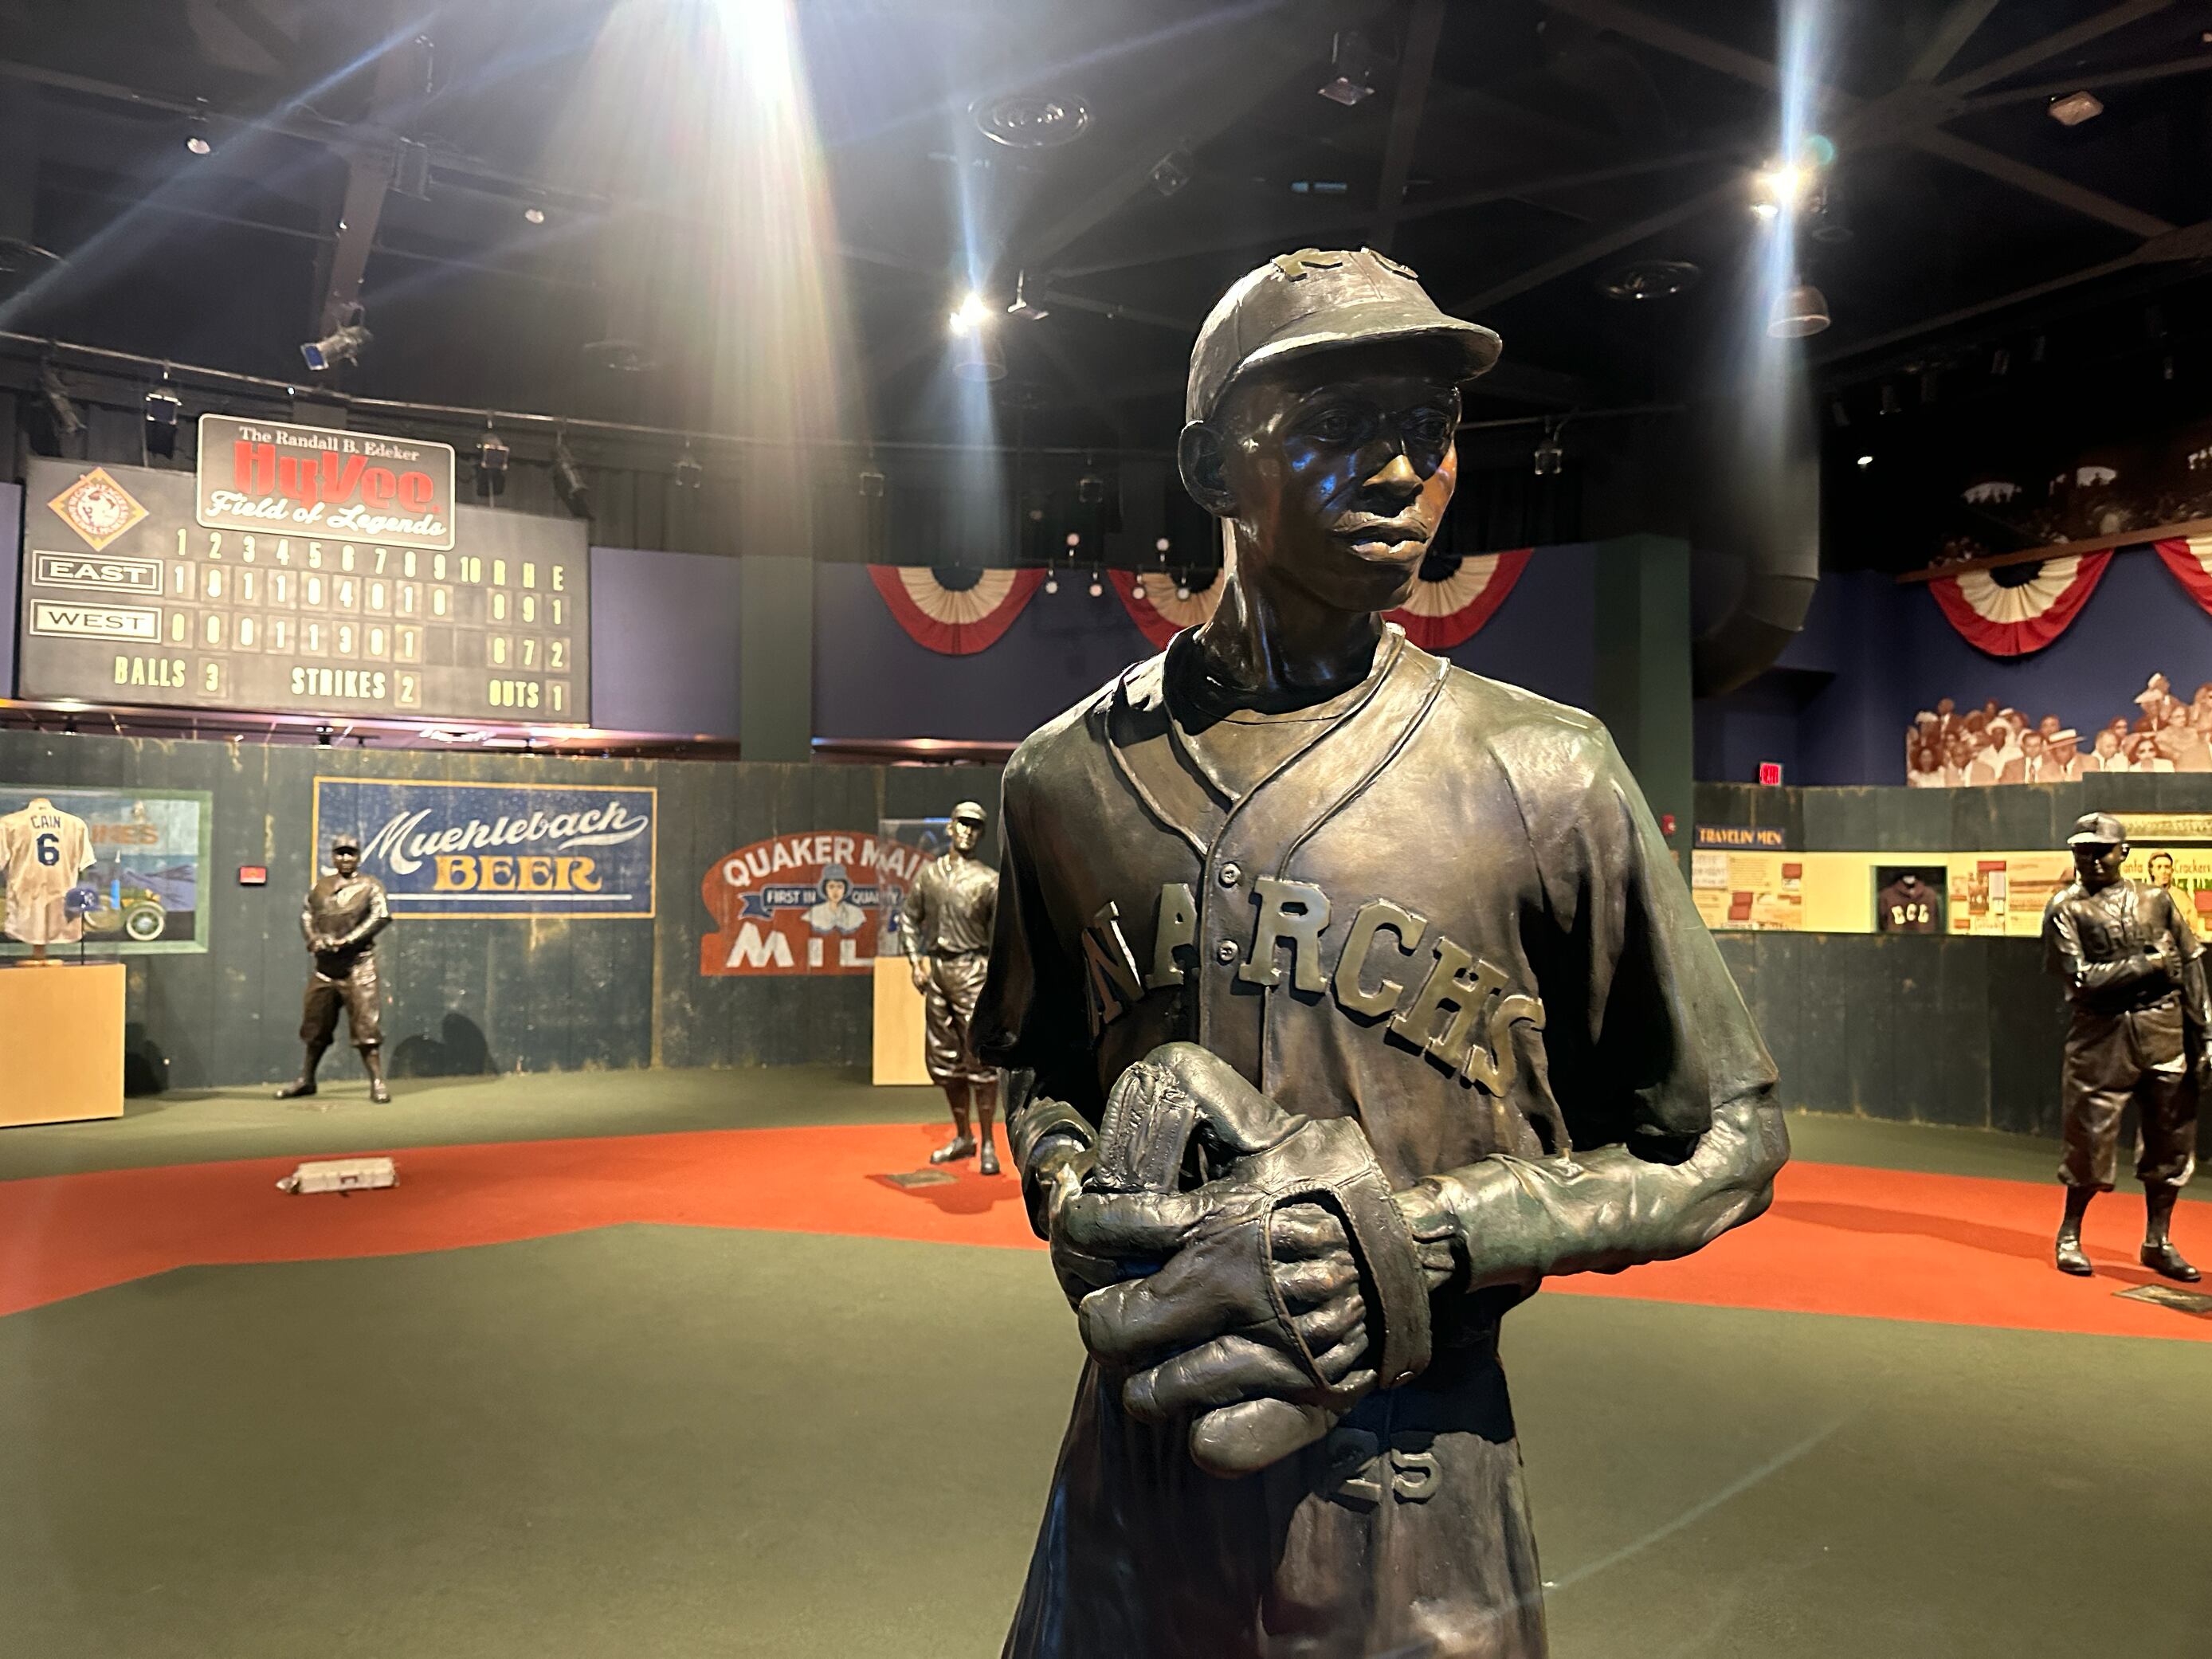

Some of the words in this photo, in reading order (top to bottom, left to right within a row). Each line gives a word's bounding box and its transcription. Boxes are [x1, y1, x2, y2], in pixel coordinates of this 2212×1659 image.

[240, 426, 273, 443] The
[276, 430, 339, 452] Randall
[343, 439, 360, 453] B.
[364, 441, 421, 461] Edeker
[205, 489, 288, 520] Field
[292, 501, 326, 524] of
[327, 504, 446, 536] Legends
[178, 528, 186, 555] 1
[208, 531, 220, 559] 2
[243, 535, 256, 563] 3
[276, 539, 290, 566] 4
[309, 542, 322, 569] 5
[342, 545, 355, 571] 6
[375, 547, 386, 575] 7
[460, 556, 481, 583] 10
[553, 566, 563, 591] E
[49, 561, 148, 584] EAST
[175, 566, 184, 594] 1
[207, 569, 222, 598] 0
[244, 572, 253, 600] 1
[276, 575, 286, 602] 1
[308, 578, 321, 605] 0
[339, 581, 354, 608] 4
[371, 582, 384, 610] 0
[404, 586, 414, 613] 1
[433, 589, 446, 616] 0
[523, 596, 535, 622] 9
[553, 599, 562, 625] 1
[48, 610, 146, 631] WEST
[115, 656, 186, 688] BALLS
[206, 663, 218, 691] 3
[292, 667, 386, 699] STRIKES
[401, 676, 414, 703] 2
[489, 680, 539, 708] OUTS
[552, 684, 563, 711] 1
[31, 814, 61, 830] CAIN
[321, 802, 649, 876] Muehlebach
[1757, 830, 1782, 845] MEN
[37, 833, 60, 866] 6
[722, 836, 857, 887] QUAKER
[2123, 860, 2143, 873] anta
[433, 855, 602, 892] BEER
[767, 890, 800, 904] FIRST
[802, 890, 817, 904] IN
[726, 921, 874, 967] MIL
